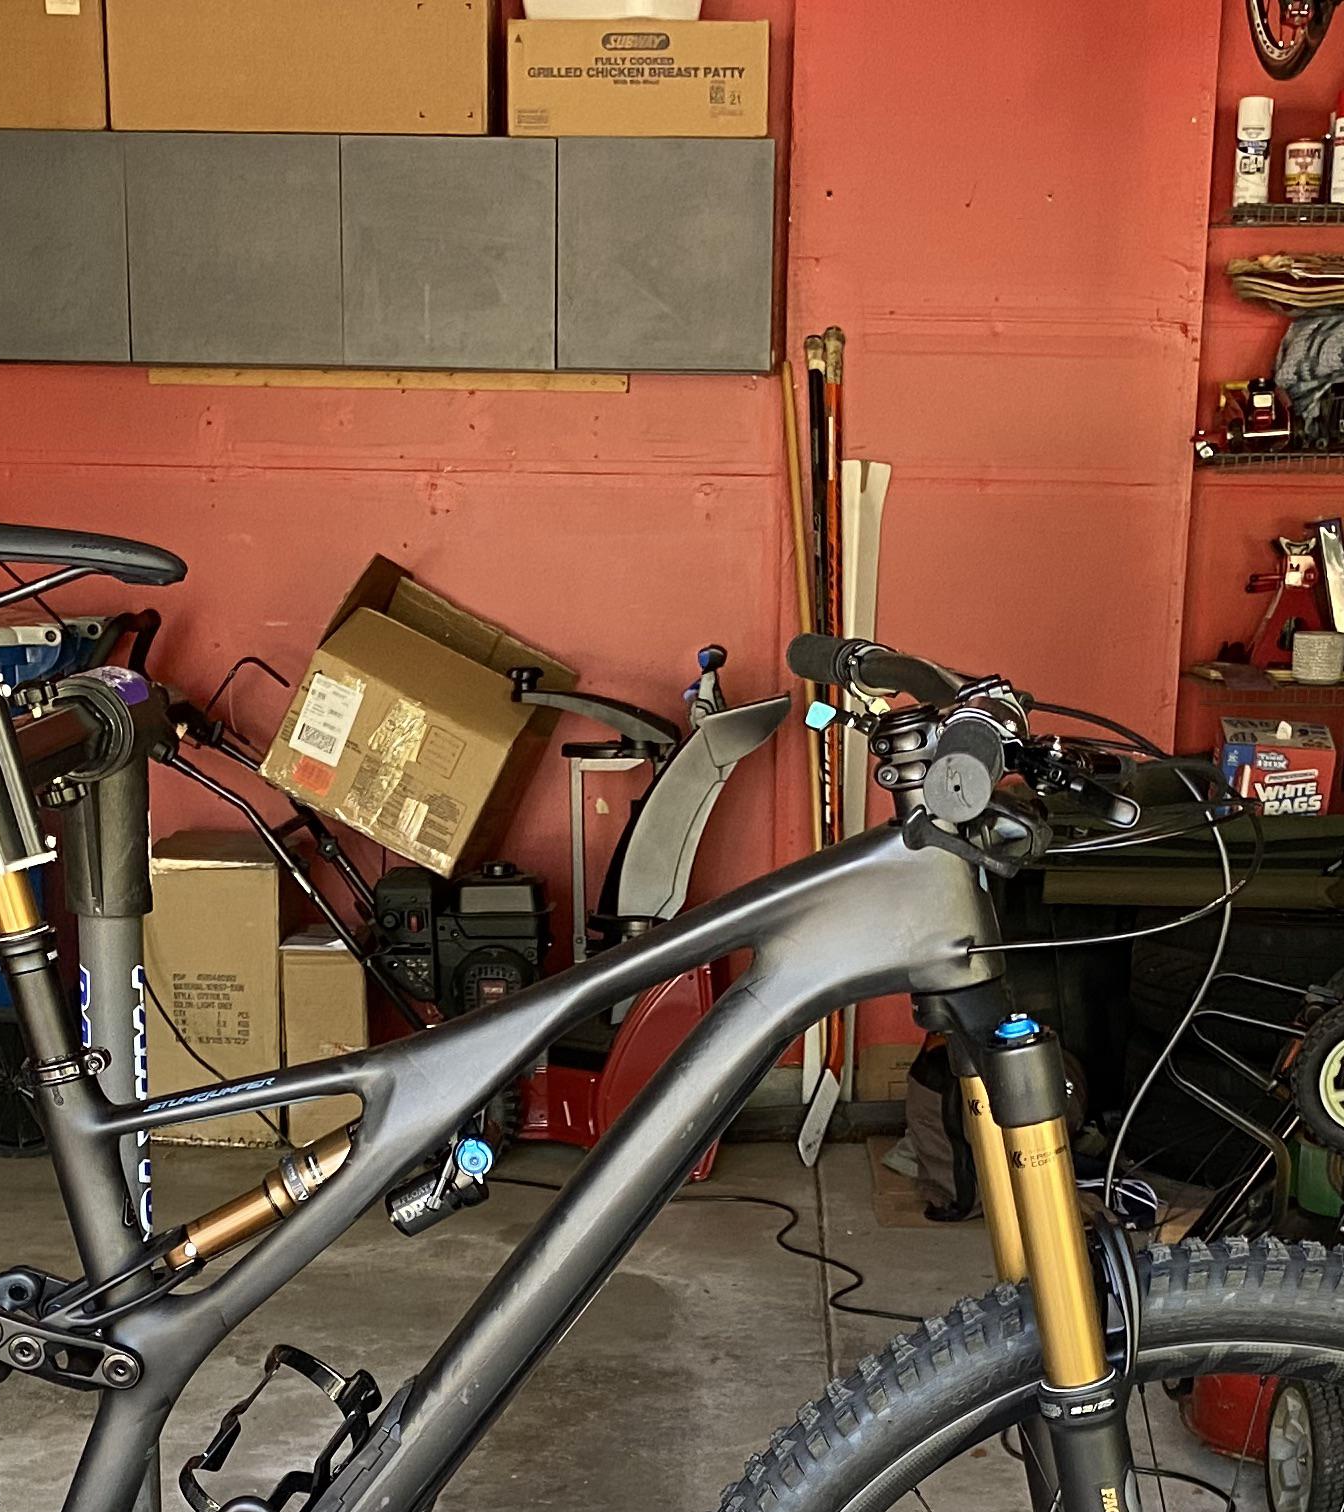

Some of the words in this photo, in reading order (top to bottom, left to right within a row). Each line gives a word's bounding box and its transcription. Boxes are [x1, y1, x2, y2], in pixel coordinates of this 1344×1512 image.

[606, 35, 665, 49] SUBWAY
[594, 57, 626, 66] FULLY
[630, 57, 674, 66] COOKED
[527, 67, 583, 78] GRILLED
[586, 67, 645, 78] CHICKEN
[649, 67, 699, 78] BREAST
[703, 67, 746, 78] PATTY
[1254, 782, 1317, 802] WHITE
[1263, 795, 1322, 815] RAGS
[143, 1077, 276, 1113] STUMPJUMPER
